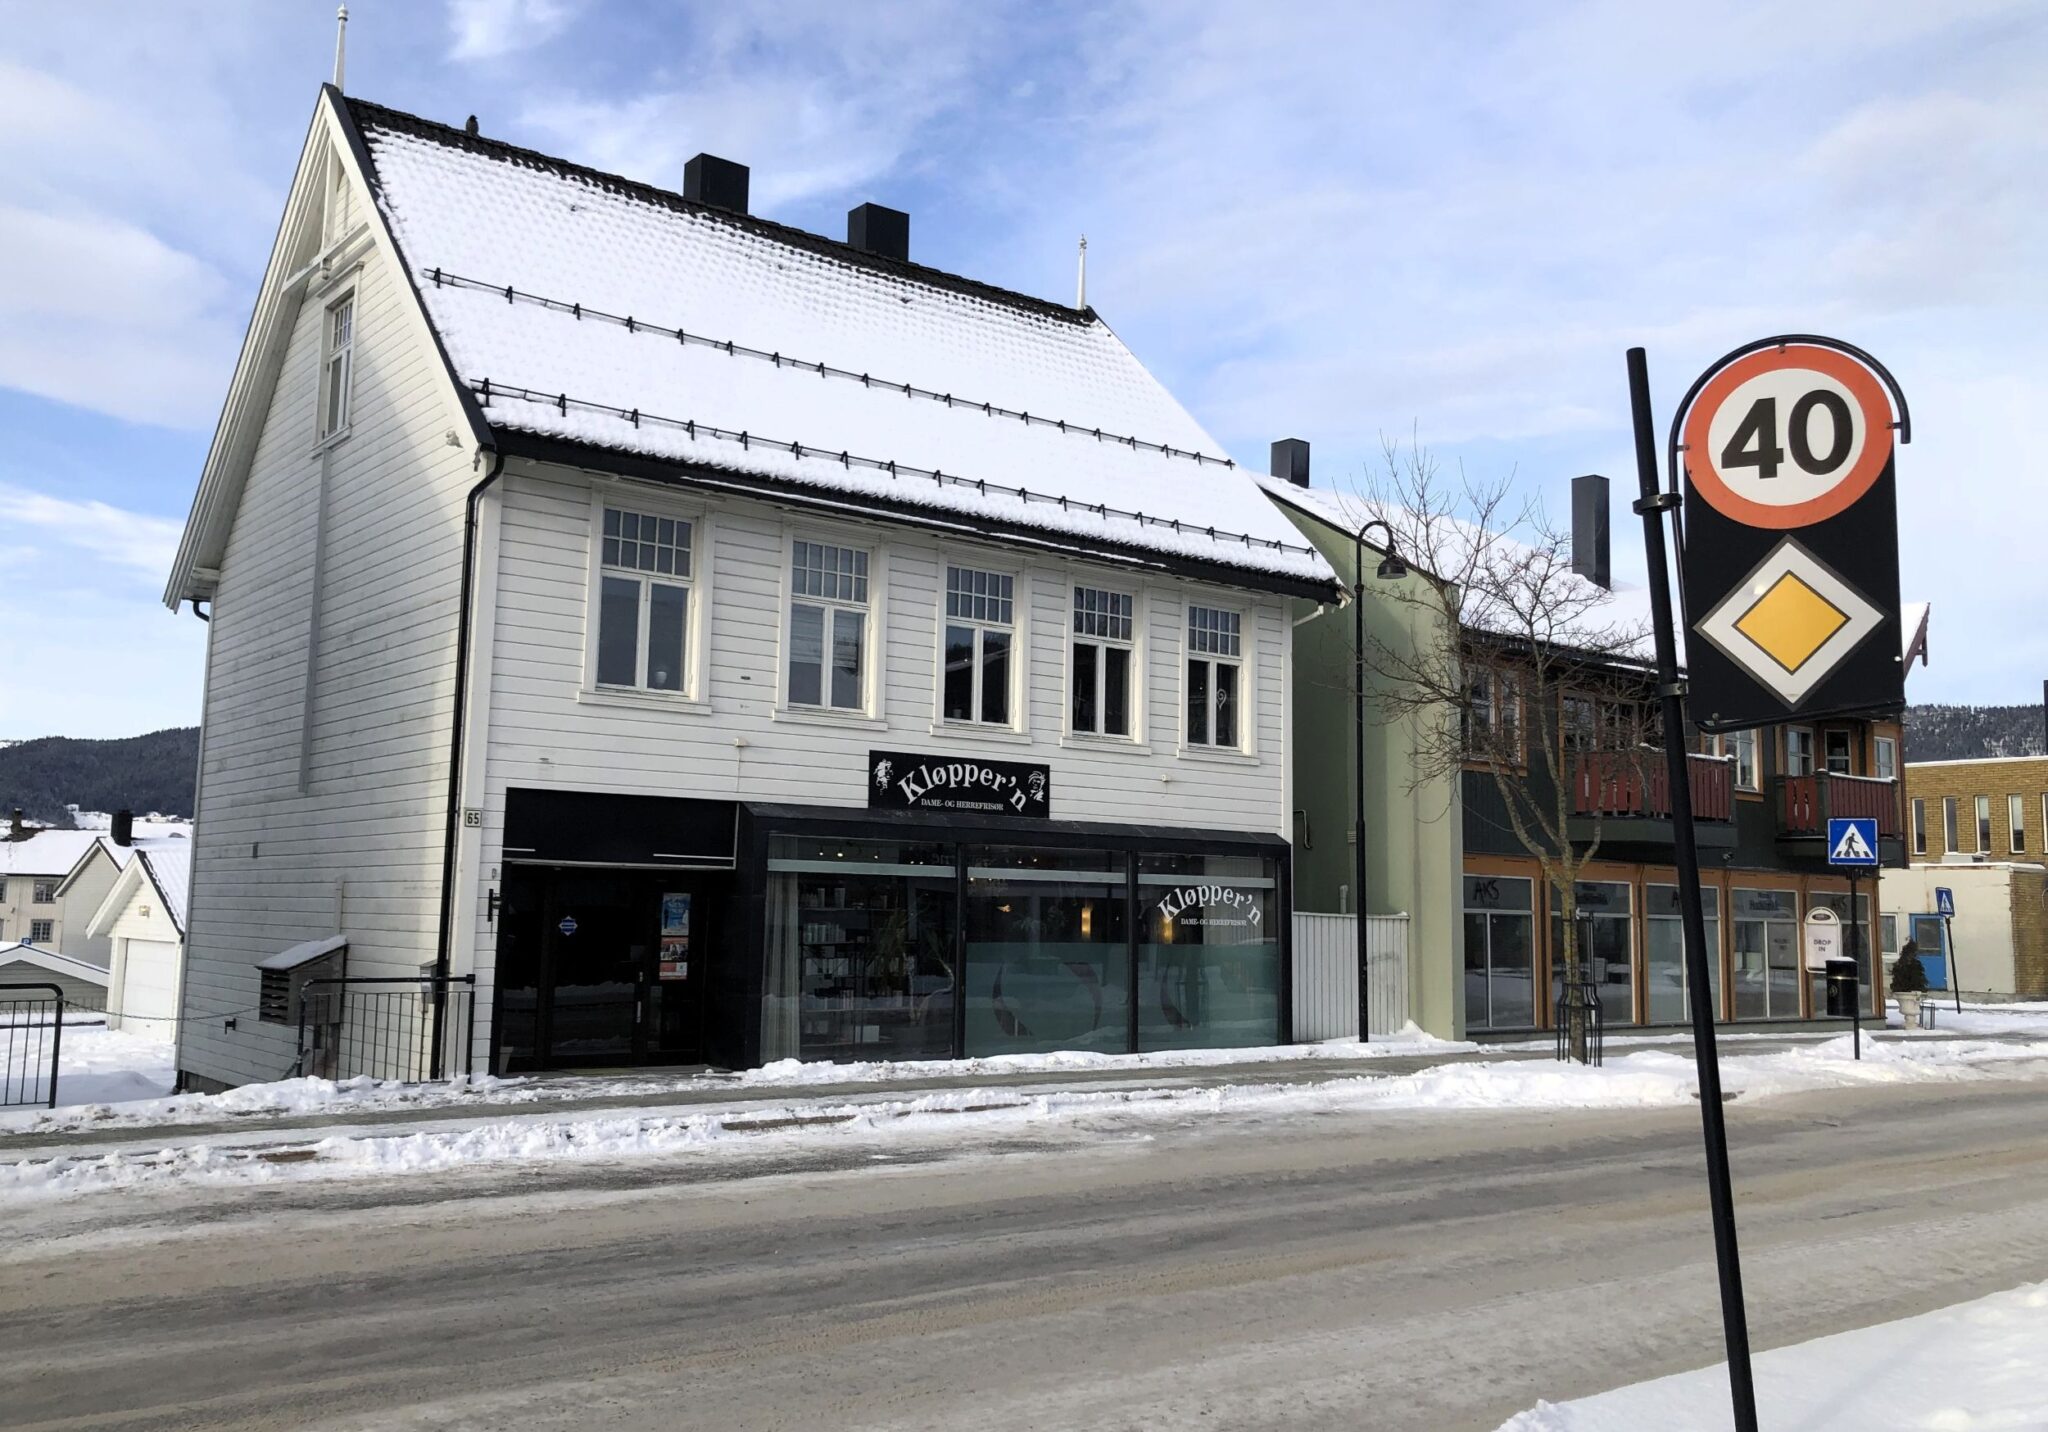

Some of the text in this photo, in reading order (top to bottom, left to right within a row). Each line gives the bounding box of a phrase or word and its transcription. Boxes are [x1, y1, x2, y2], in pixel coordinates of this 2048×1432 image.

[1721, 389, 1853, 479] 40
[921, 798, 944, 807] DAME-
[944, 800, 955, 808] OG
[467, 812, 480, 825] 65
[1473, 879, 1500, 904] AKS
[1813, 938, 1831, 946] DROP
